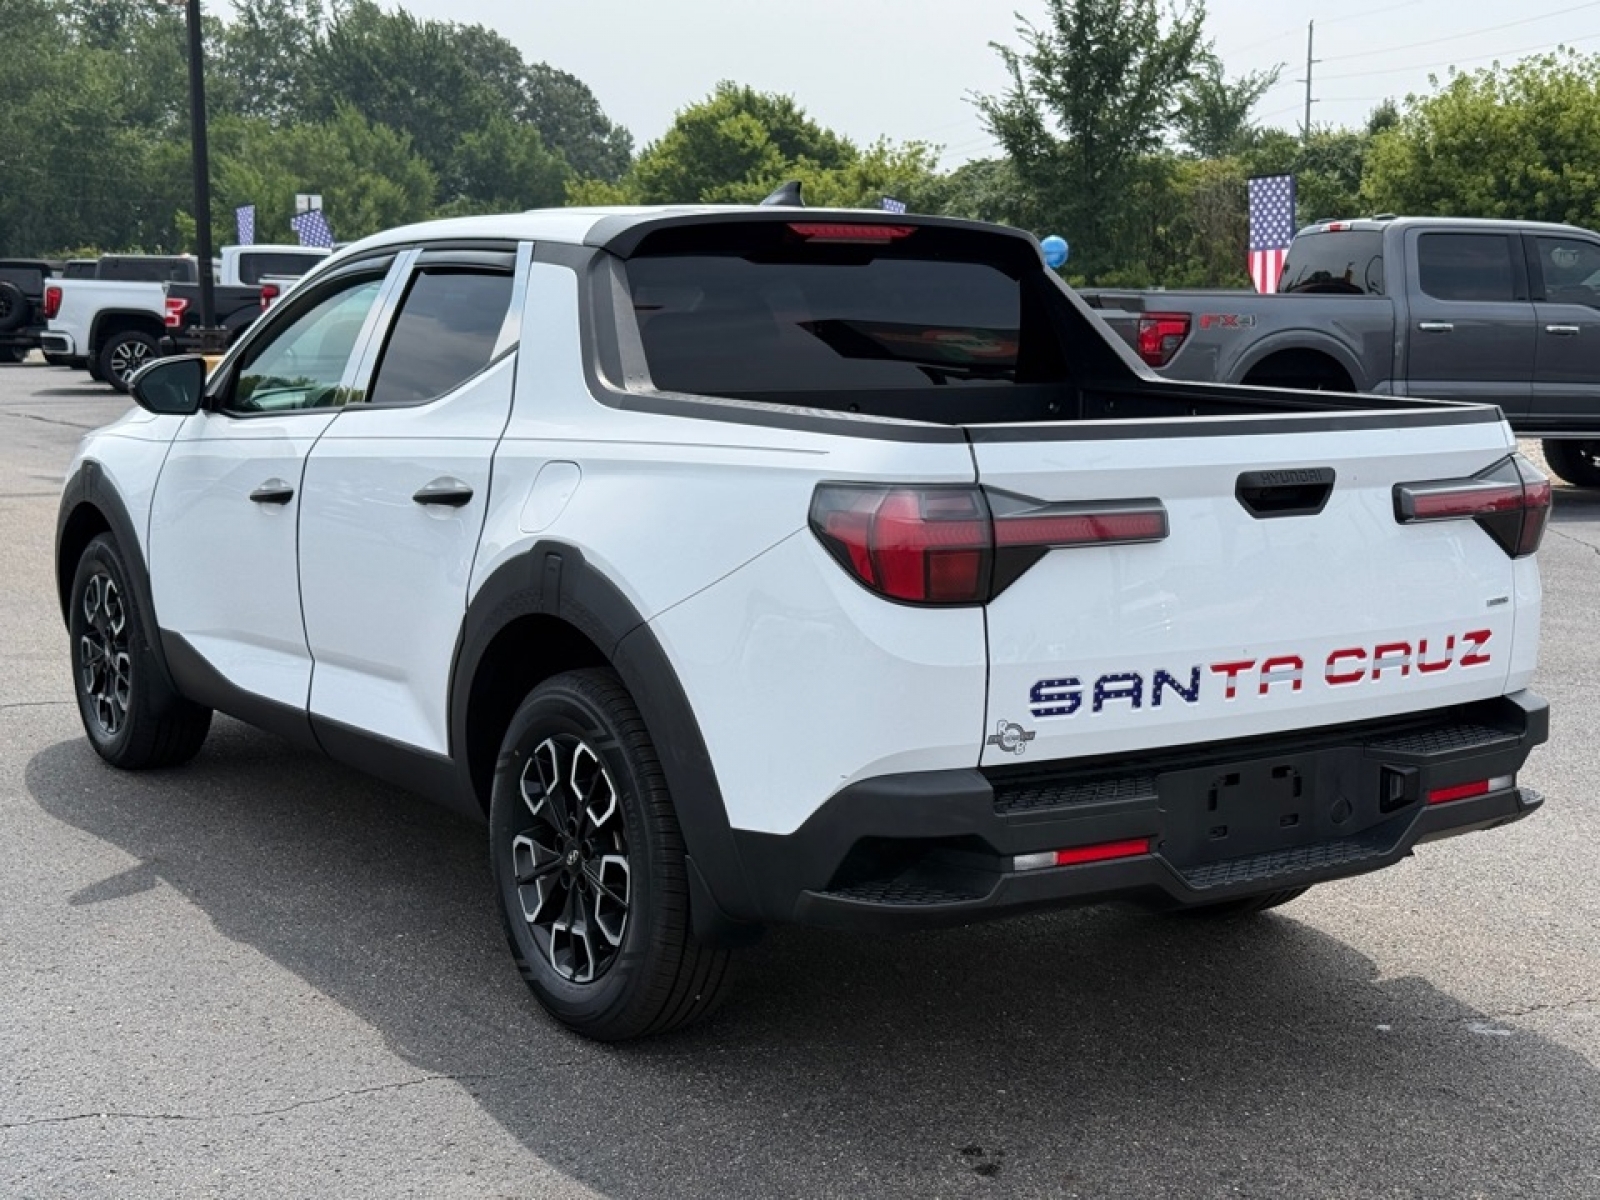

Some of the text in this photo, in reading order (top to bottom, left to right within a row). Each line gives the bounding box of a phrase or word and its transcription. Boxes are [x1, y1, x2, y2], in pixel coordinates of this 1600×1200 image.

[1260, 469, 1322, 484] HYUNDAI
[1029, 629, 1493, 718] SANTA CRUZ
